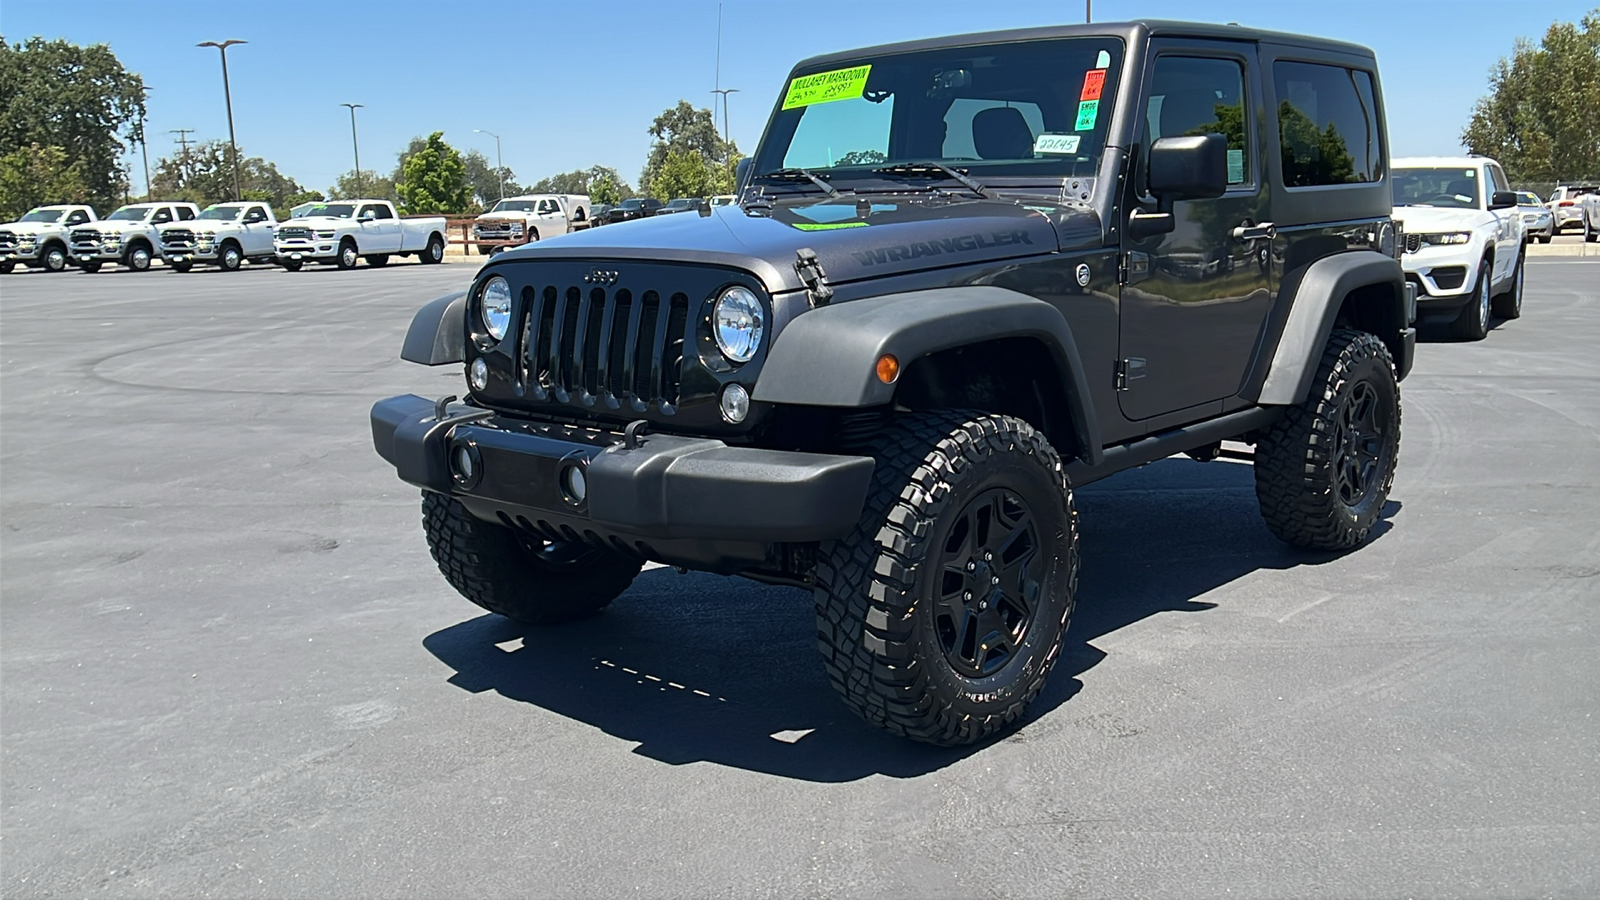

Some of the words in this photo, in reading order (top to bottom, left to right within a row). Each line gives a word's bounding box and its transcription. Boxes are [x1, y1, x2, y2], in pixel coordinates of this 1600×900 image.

[827, 67, 869, 84] MARKDOWN
[1081, 102, 1097, 111] SMOG
[852, 229, 1033, 267] WRANGLER
